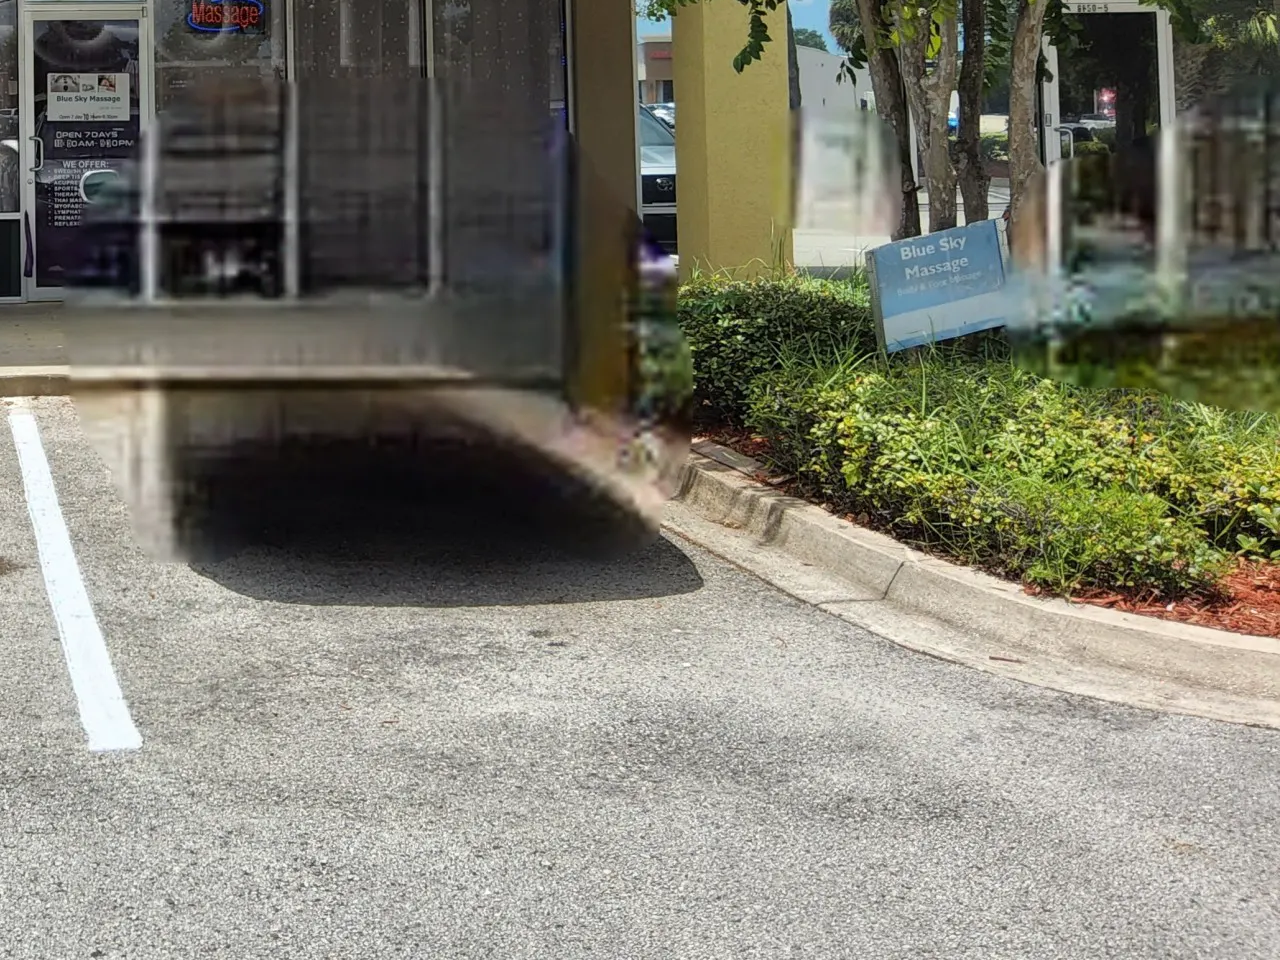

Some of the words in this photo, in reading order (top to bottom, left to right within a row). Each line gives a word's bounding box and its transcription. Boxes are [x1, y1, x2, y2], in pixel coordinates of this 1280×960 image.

[191, 0, 259, 28] Massage
[74, 95, 88, 103] Sky
[89, 95, 121, 103] Massage
[55, 131, 82, 139] OPEN
[62, 160, 77, 169] WE
[78, 160, 110, 169] OFFER:
[899, 244, 936, 261] Blue
[939, 236, 967, 251] Sky
[904, 257, 970, 280] Massage
